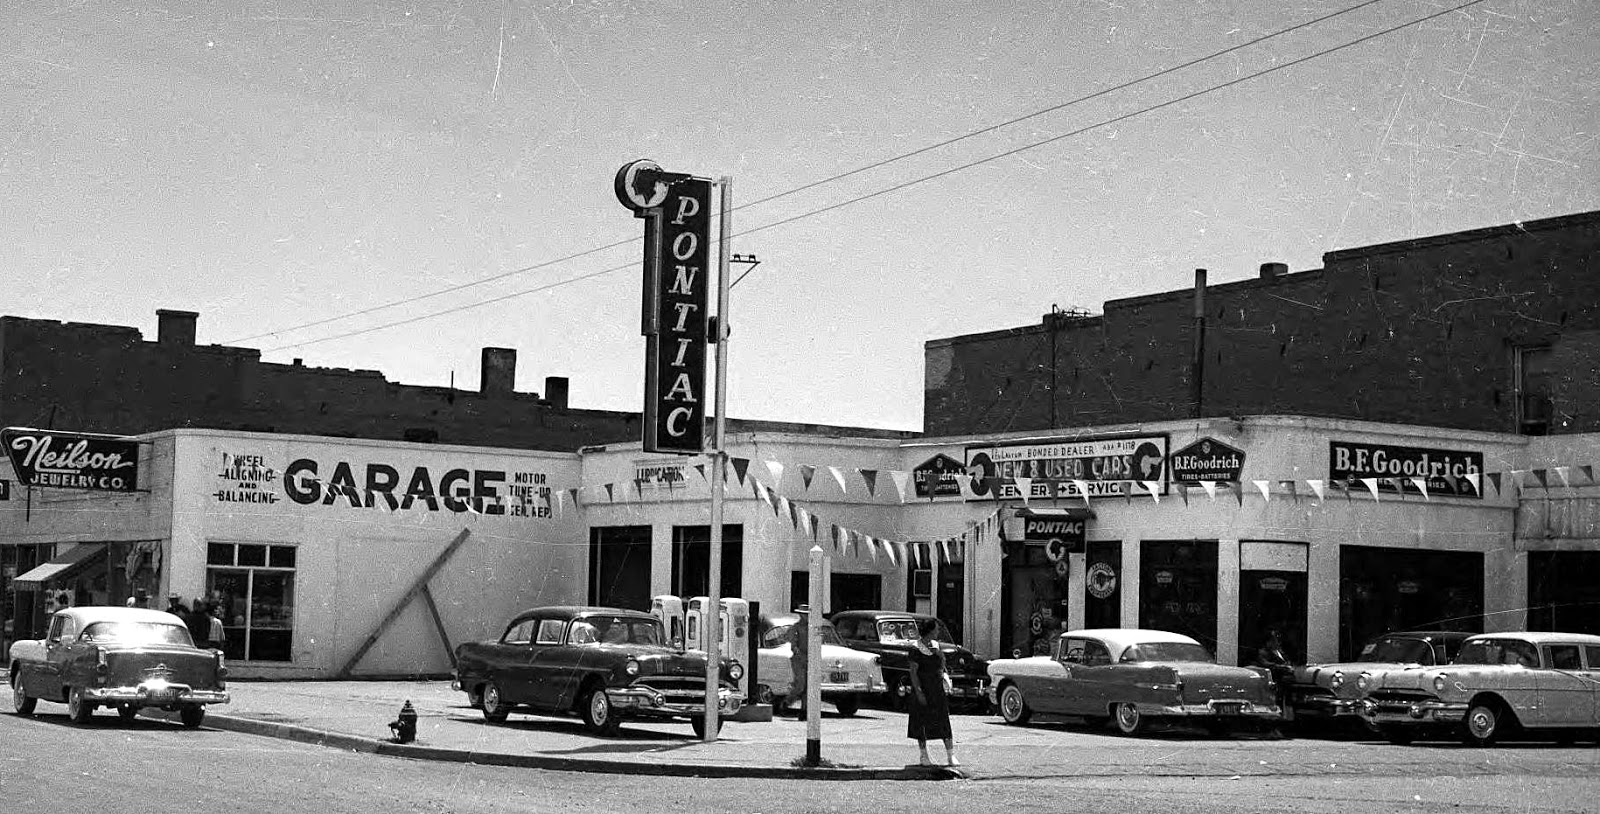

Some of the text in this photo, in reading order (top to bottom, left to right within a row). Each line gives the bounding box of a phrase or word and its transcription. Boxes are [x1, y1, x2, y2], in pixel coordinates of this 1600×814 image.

[664, 196, 700, 437] PONTIAC
[12, 435, 134, 474] Neilson
[1061, 445, 1095, 456] DEALER
[994, 455, 1133, 479] NEW & USED CARS
[1174, 455, 1240, 470] B.F.Goodrich
[30, 473, 96, 487] JEWELRY
[515, 472, 546, 484] MOTOR
[284, 458, 506, 516] GARAGE
[509, 485, 551, 498] TUNE-UP
[1026, 521, 1083, 535] PONTIAC
